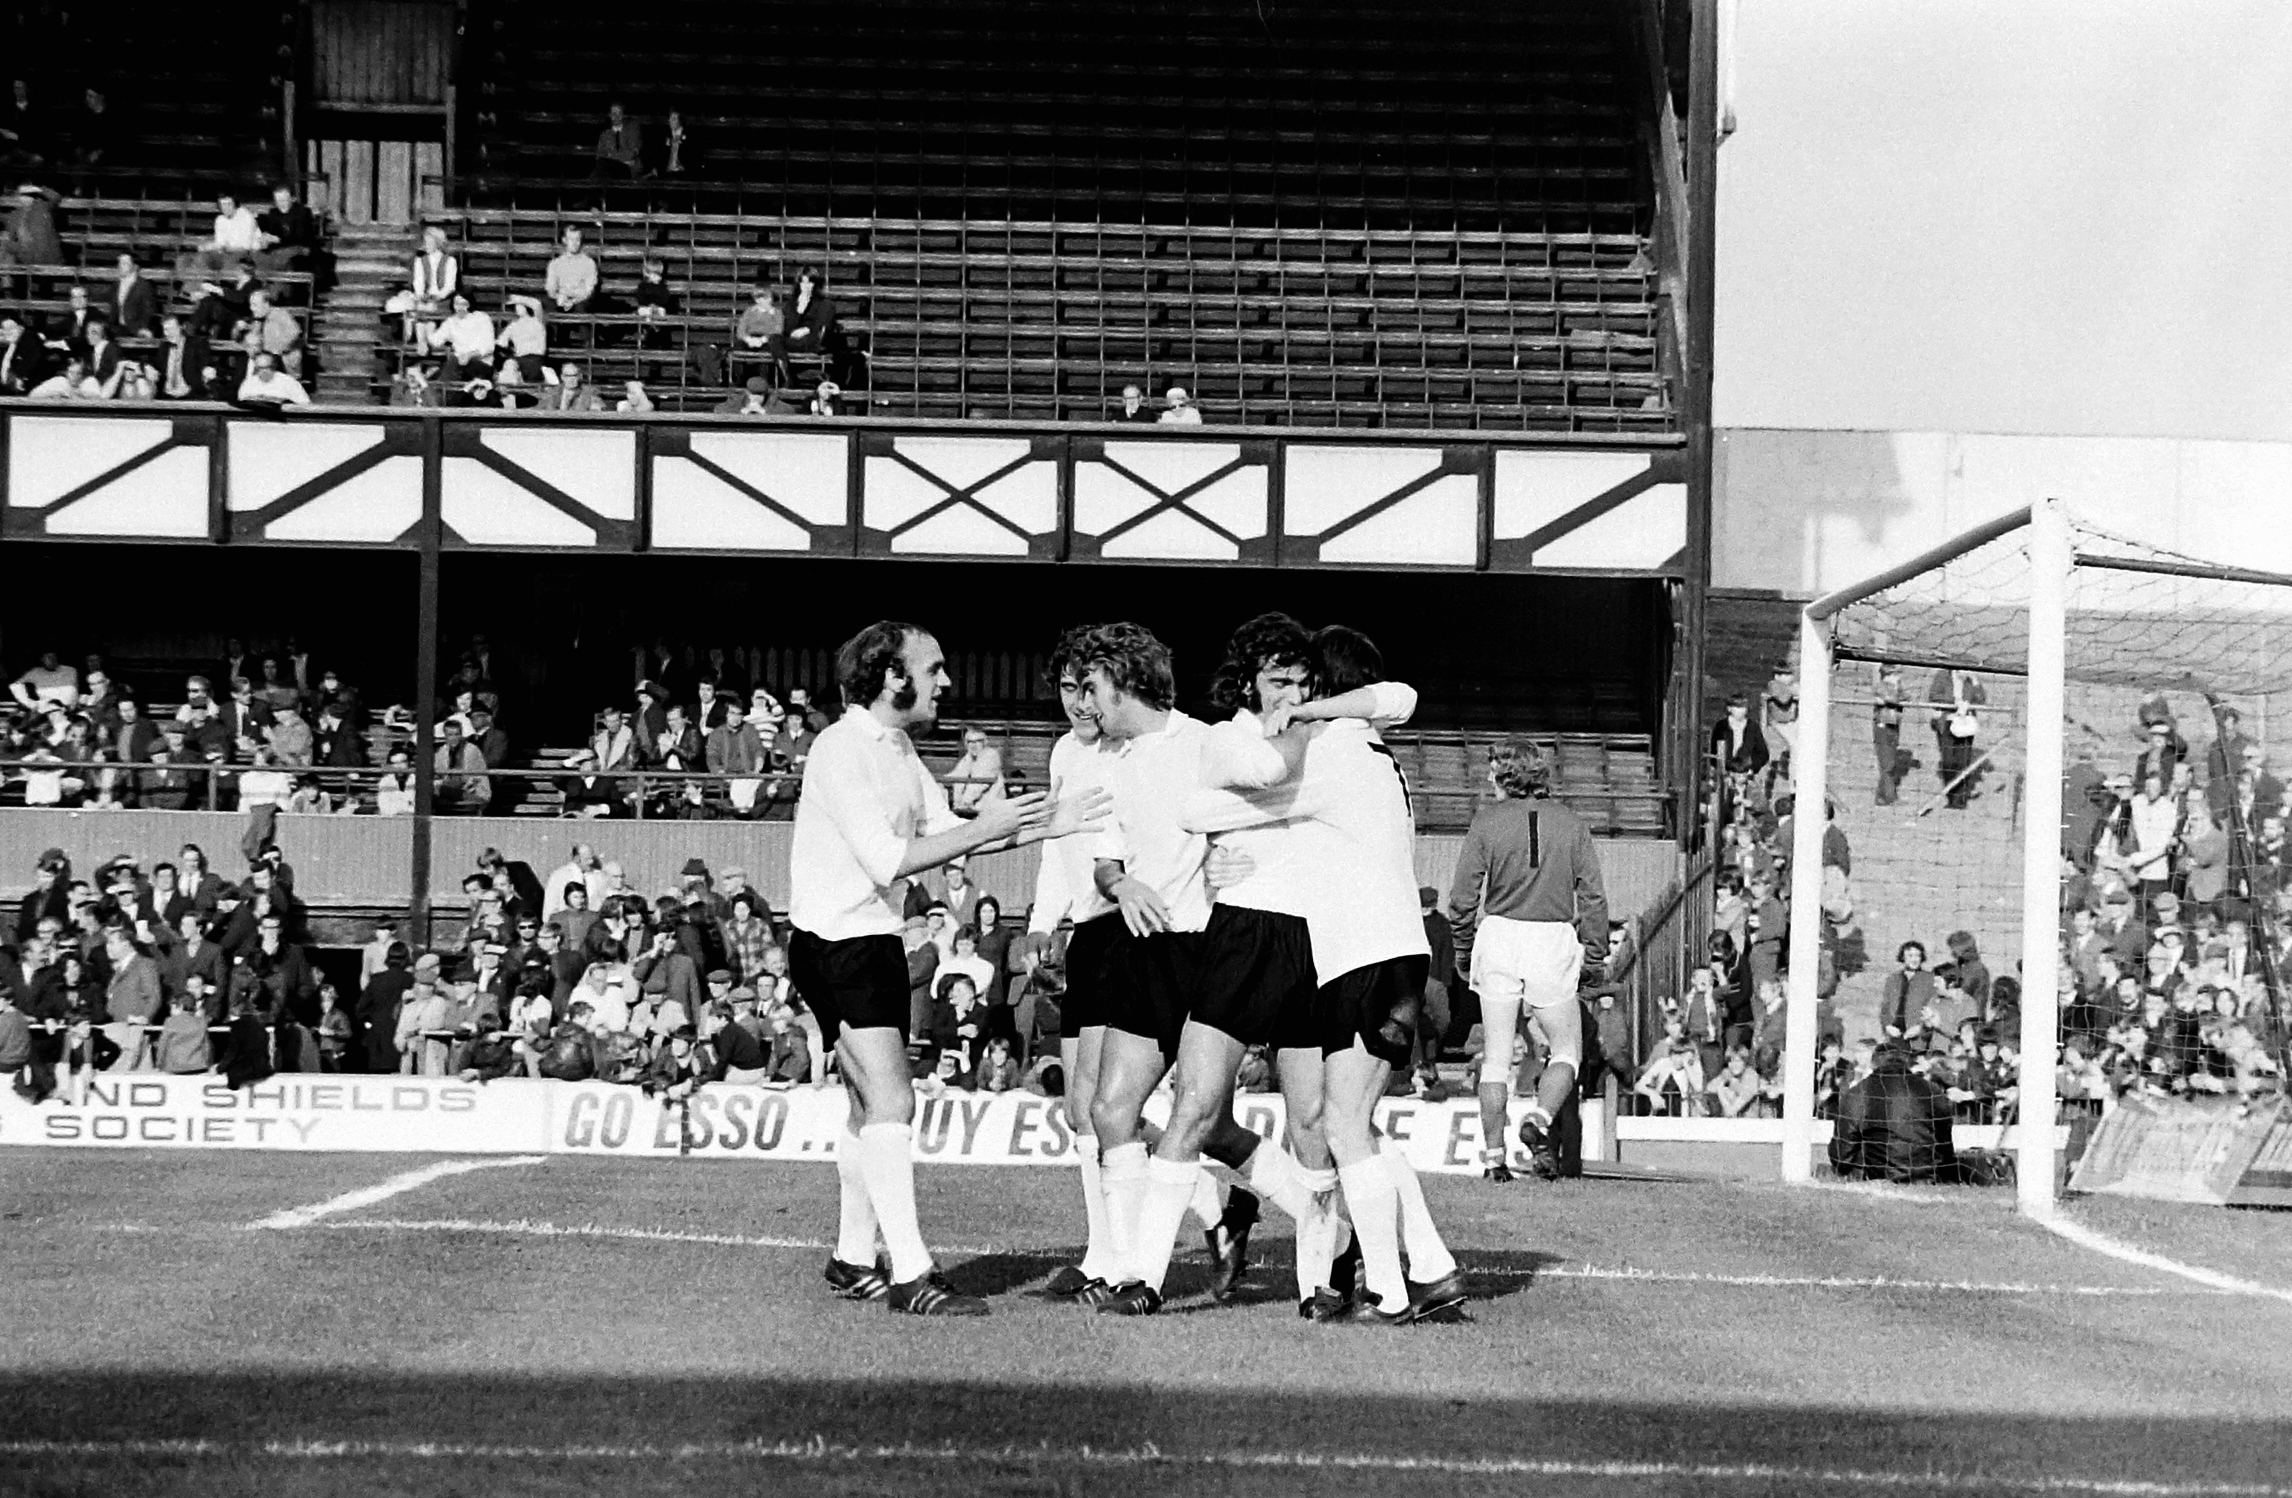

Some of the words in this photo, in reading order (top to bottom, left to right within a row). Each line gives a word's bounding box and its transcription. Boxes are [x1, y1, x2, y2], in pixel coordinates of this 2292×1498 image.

[1528, 811, 1539, 868] 1
[34, 1083, 166, 1107] ND
[203, 1083, 476, 1112] SHIELDS
[46, 1115, 322, 1144] SOCIETY
[565, 1091, 634, 1149] GO
[918, 1099, 992, 1155] UY
